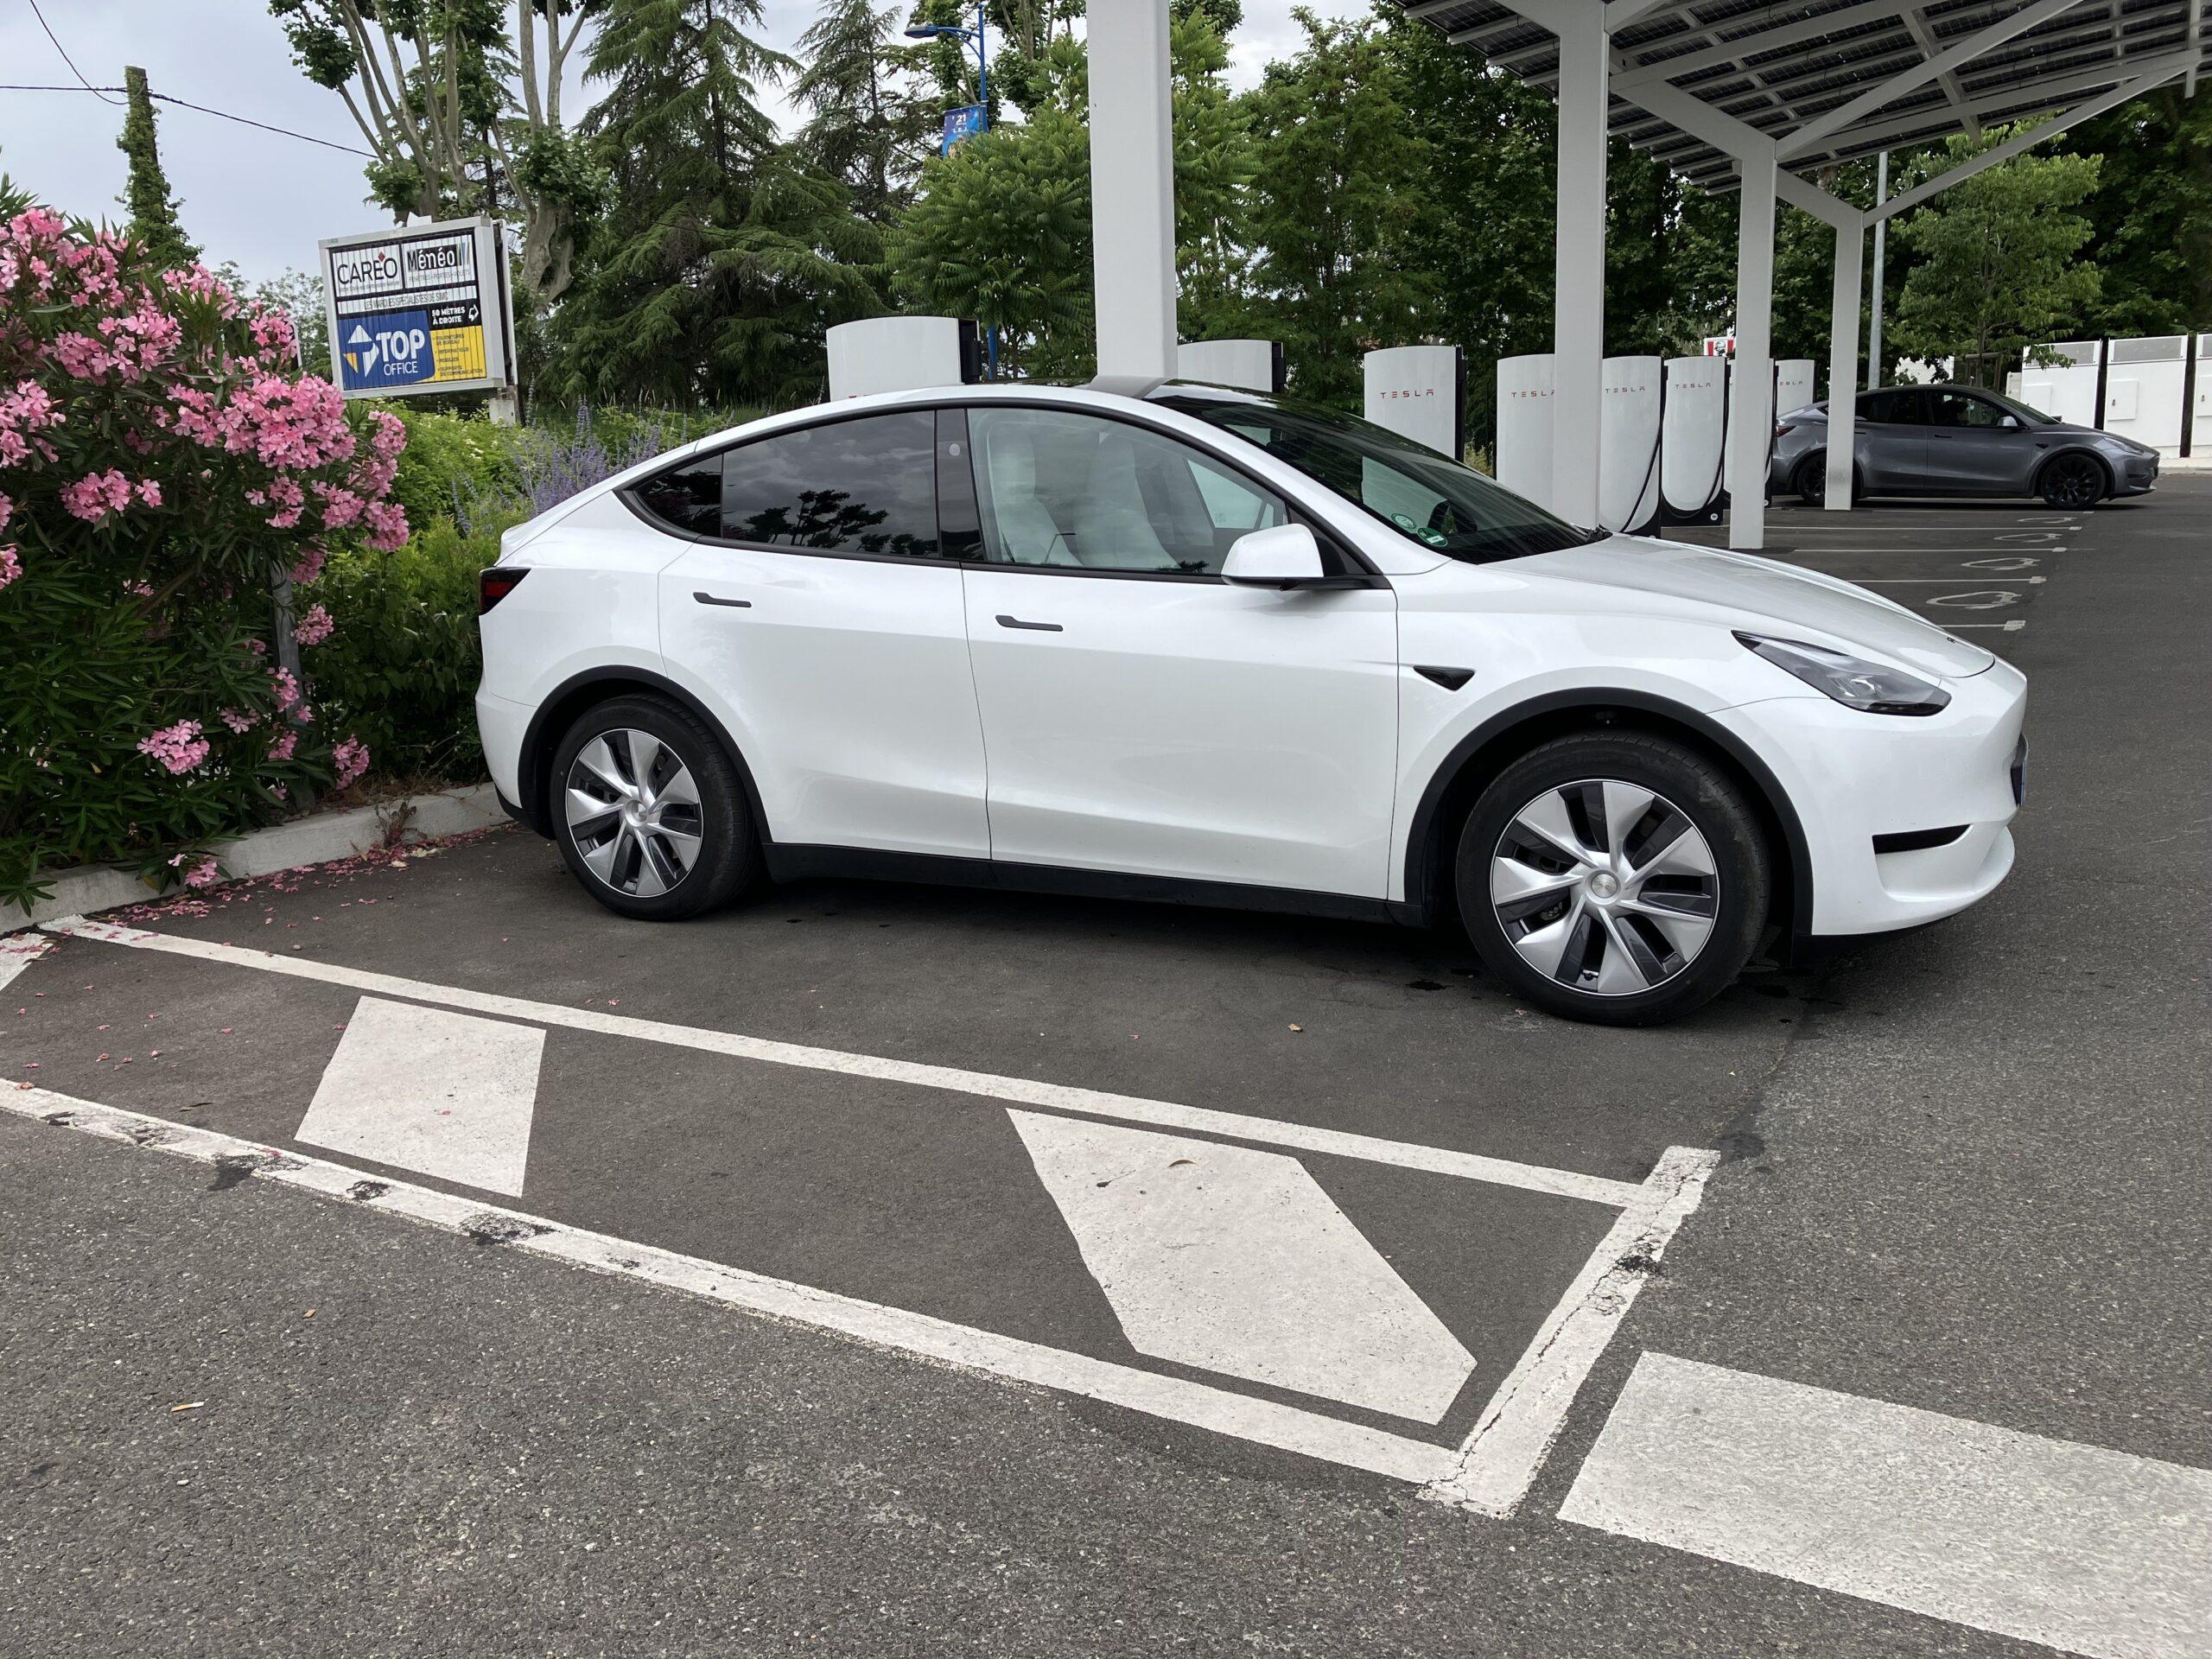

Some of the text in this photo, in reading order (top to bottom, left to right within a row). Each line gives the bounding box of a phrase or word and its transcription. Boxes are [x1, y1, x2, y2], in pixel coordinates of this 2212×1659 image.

[438, 315, 461, 324] DROITE
[376, 328, 425, 362] TOP
[383, 361, 418, 376] OFFICE
[1380, 389, 1434, 398] TESLA
